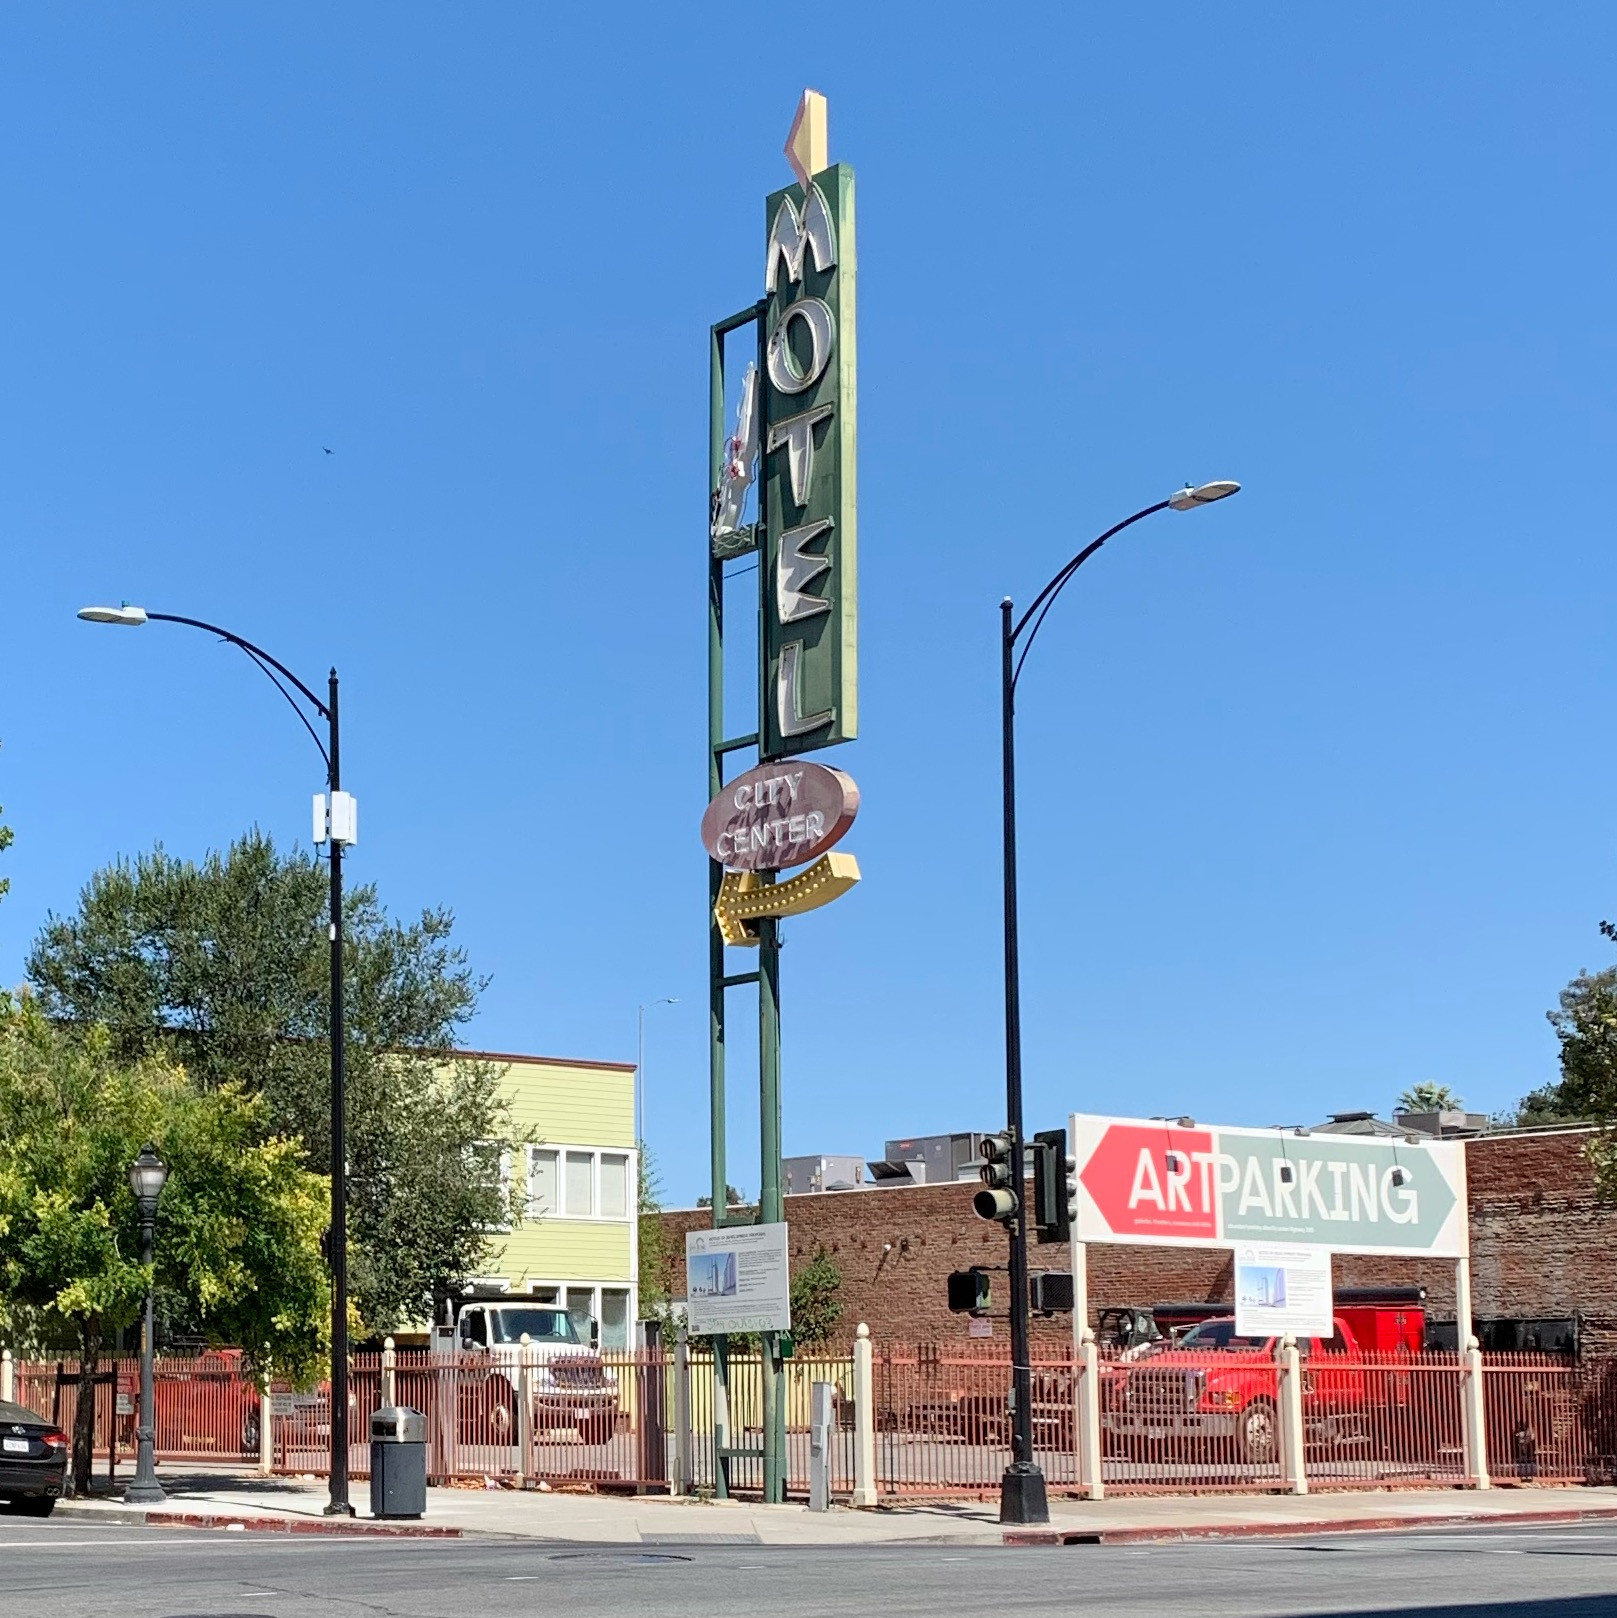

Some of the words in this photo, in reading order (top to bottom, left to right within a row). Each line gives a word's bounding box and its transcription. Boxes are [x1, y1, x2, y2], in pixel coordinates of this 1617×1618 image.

[765, 182, 836, 738] MOTEL
[734, 771, 804, 810] CITY
[717, 810, 825, 856] CENTER
[1214, 1153, 1419, 1225] PARKING
